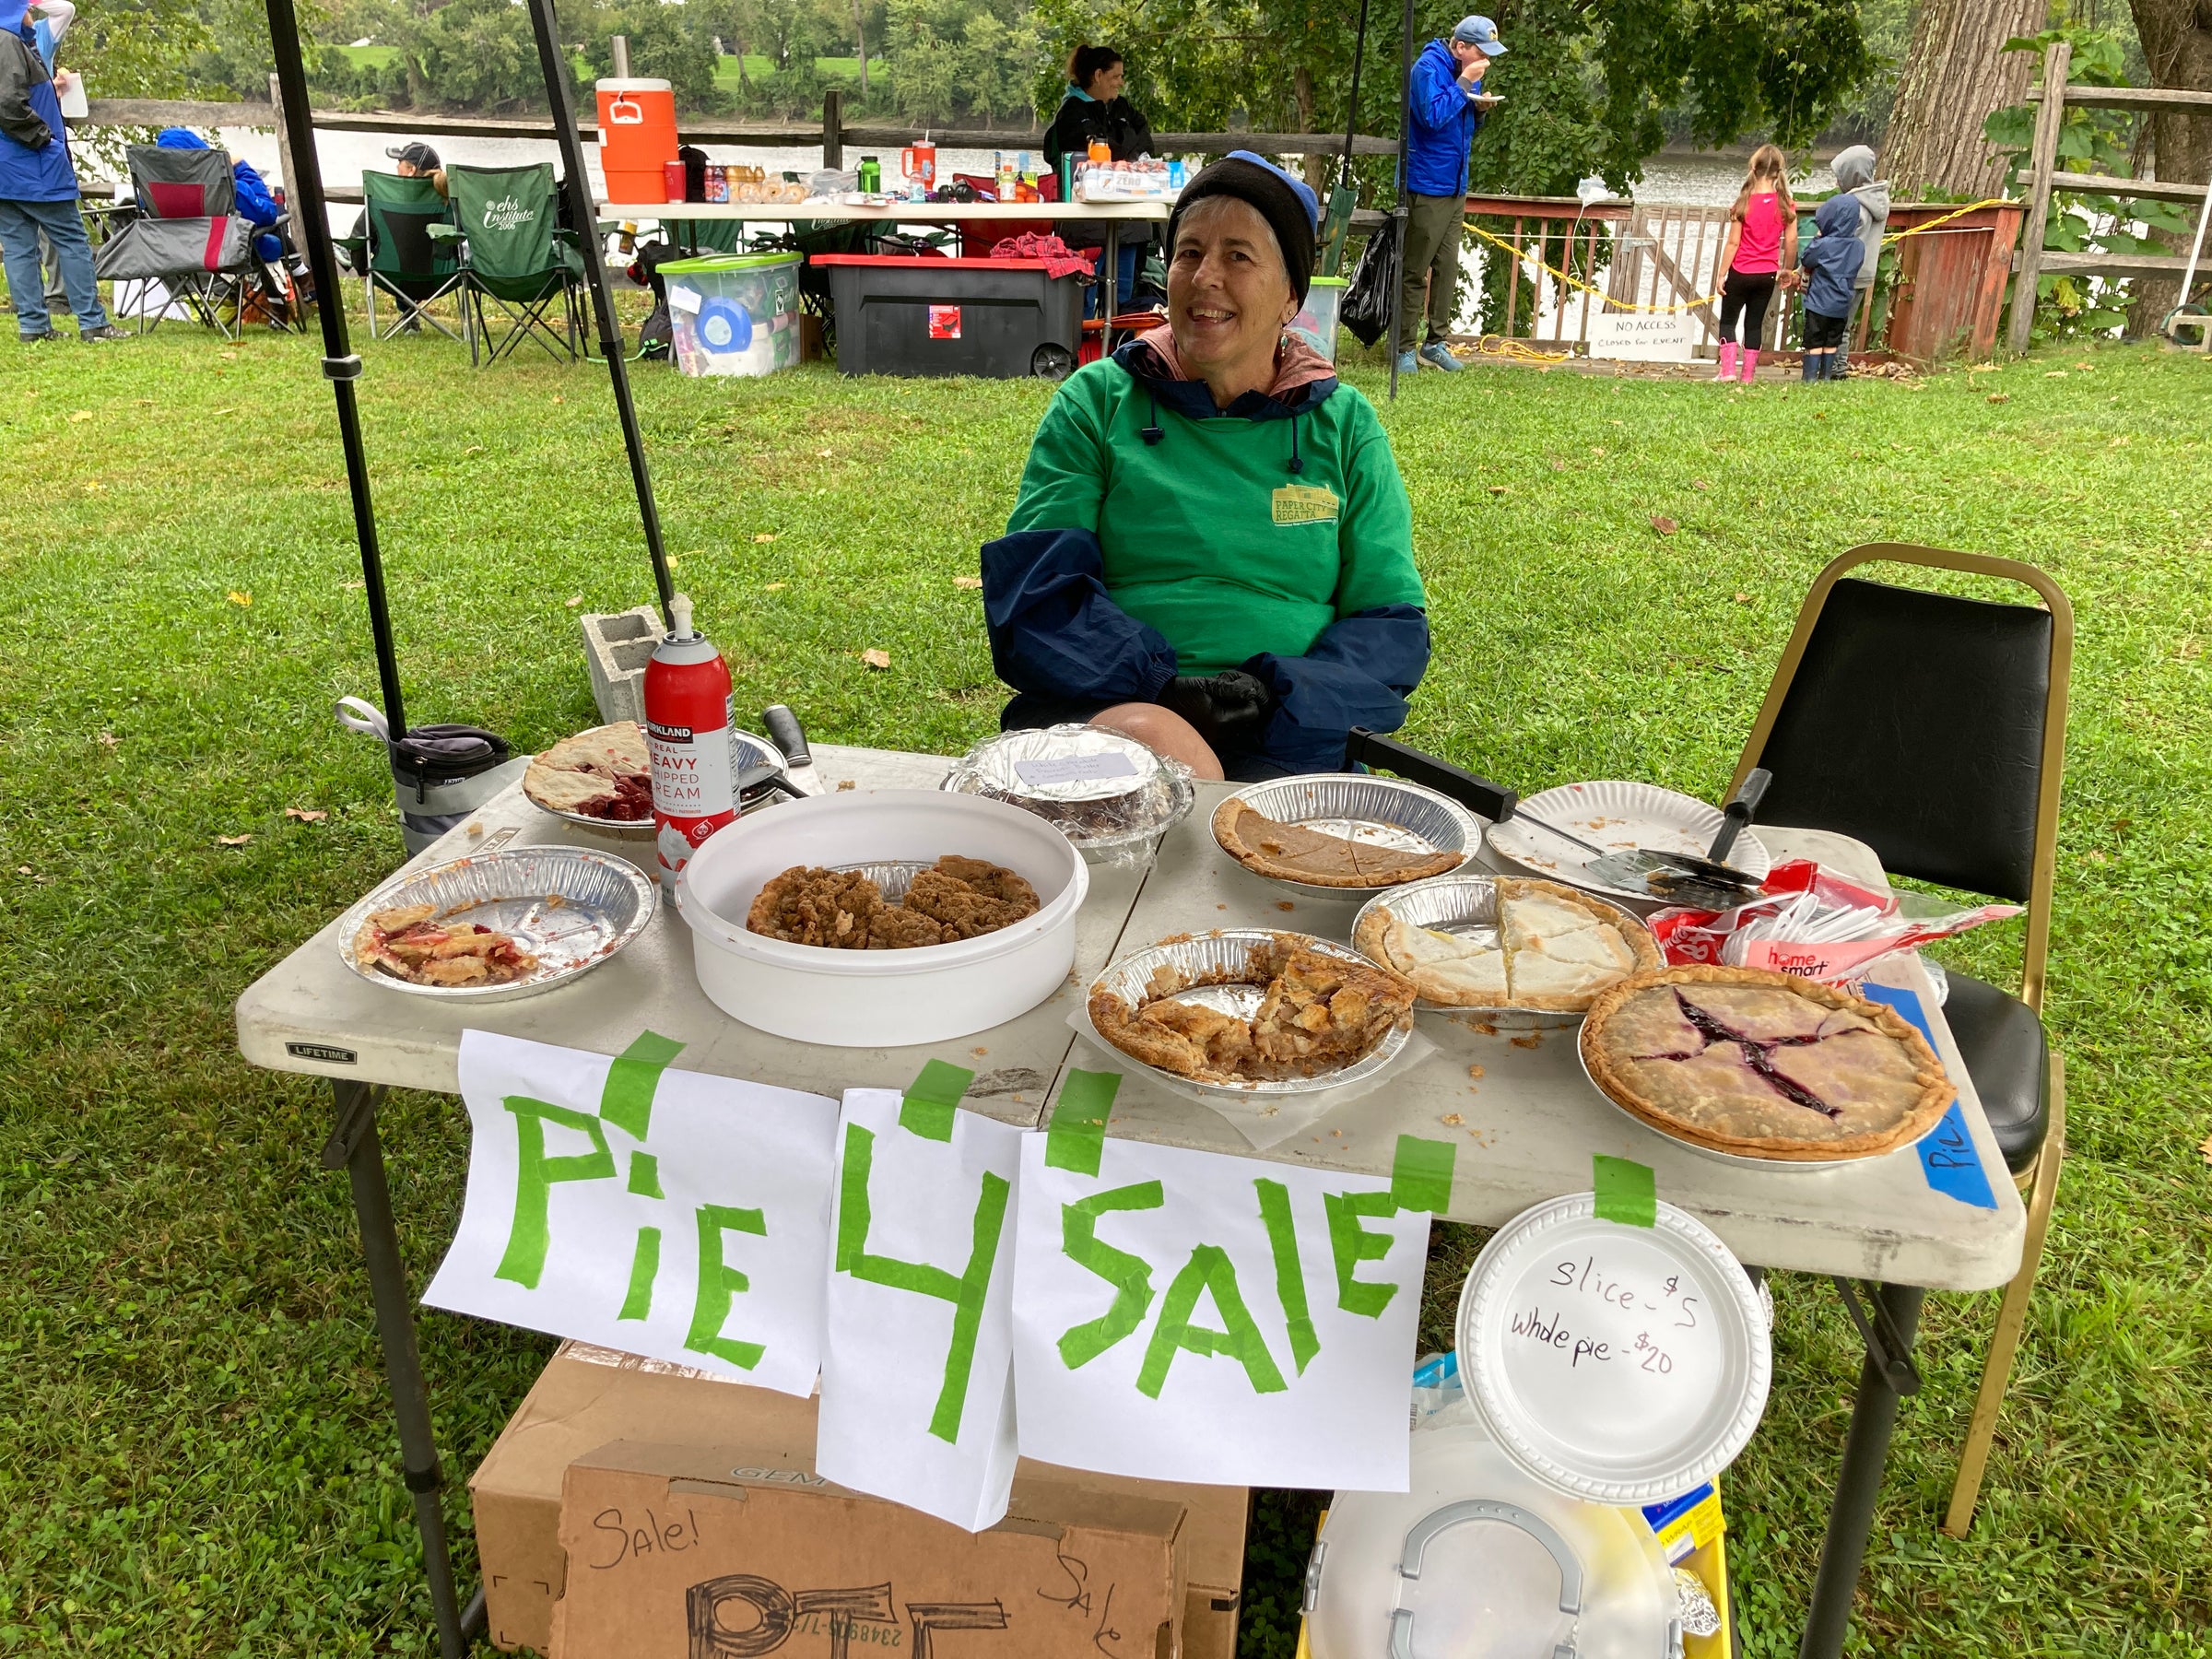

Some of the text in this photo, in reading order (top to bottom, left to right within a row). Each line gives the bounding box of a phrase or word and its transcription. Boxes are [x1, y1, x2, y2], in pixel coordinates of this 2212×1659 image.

[497, 194, 518, 211] ehs
[499, 221, 515, 230] 2006
[1617, 320, 1676, 332] NO ACCESS
[1276, 500, 1326, 512] PAPER CITY
[1276, 510, 1316, 522] REGATTA
[654, 743, 677, 754] REAL
[653, 781, 700, 799] REAM
[1768, 947, 1816, 967] home
[1781, 961, 1828, 977] smart
[296, 1046, 348, 1061] LIFETIME
[835, 1122, 1010, 1445] 4
[1572, 1335, 1611, 1368] pie
[1634, 1331, 1673, 1374] $20
